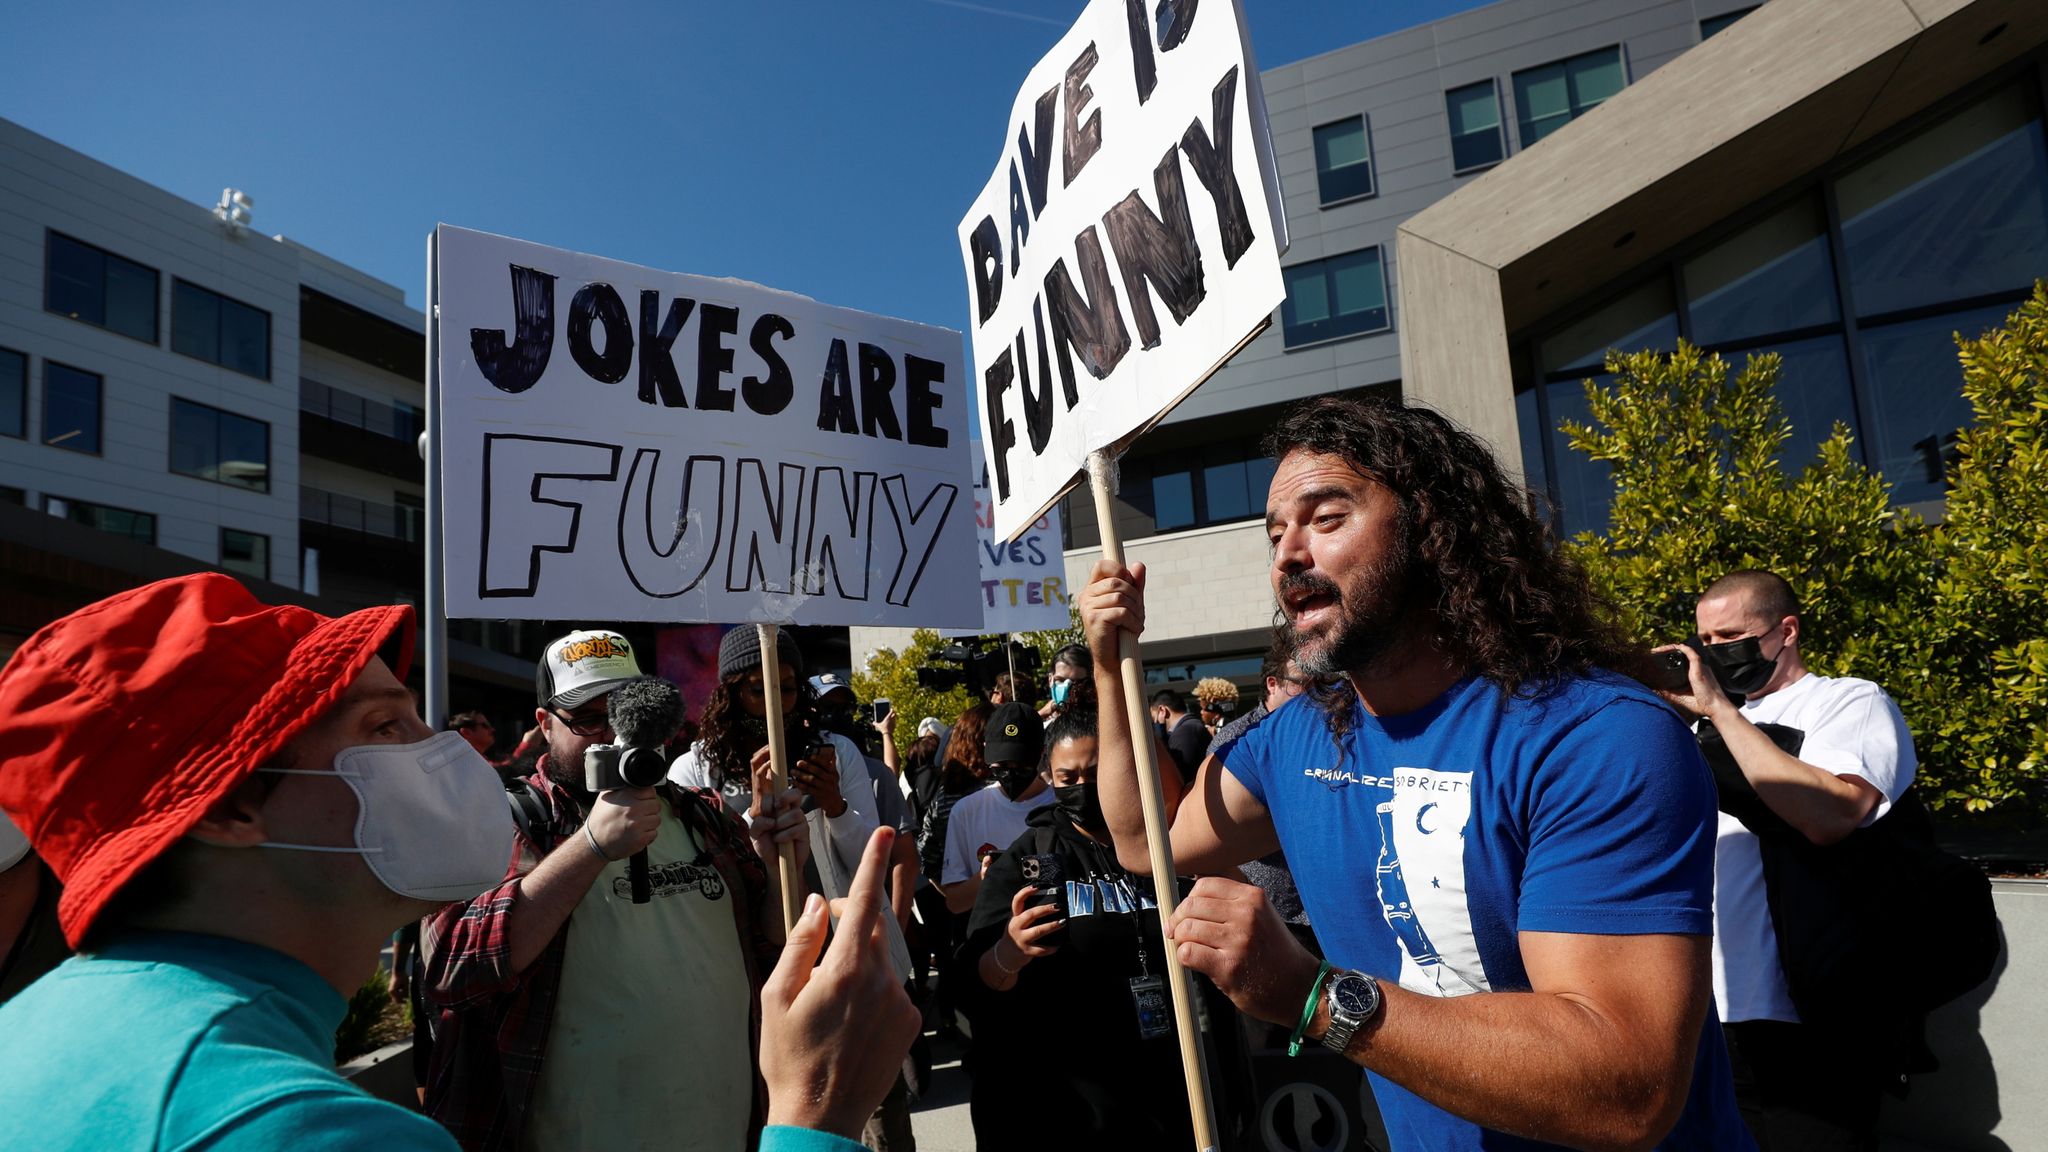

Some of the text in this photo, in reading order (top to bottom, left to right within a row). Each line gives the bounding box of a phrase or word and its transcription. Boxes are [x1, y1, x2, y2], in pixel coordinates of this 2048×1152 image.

[970, 40, 1101, 328] DAVE
[985, 65, 1255, 506] FUNNY
[470, 263, 949, 448] JOKES ARE
[479, 432, 958, 607] FUNNY
[977, 536, 1046, 568] VES
[981, 576, 1067, 608] TTER
[1395, 775, 1470, 793] SOBRIETY
[701, 878, 720, 894] 86
